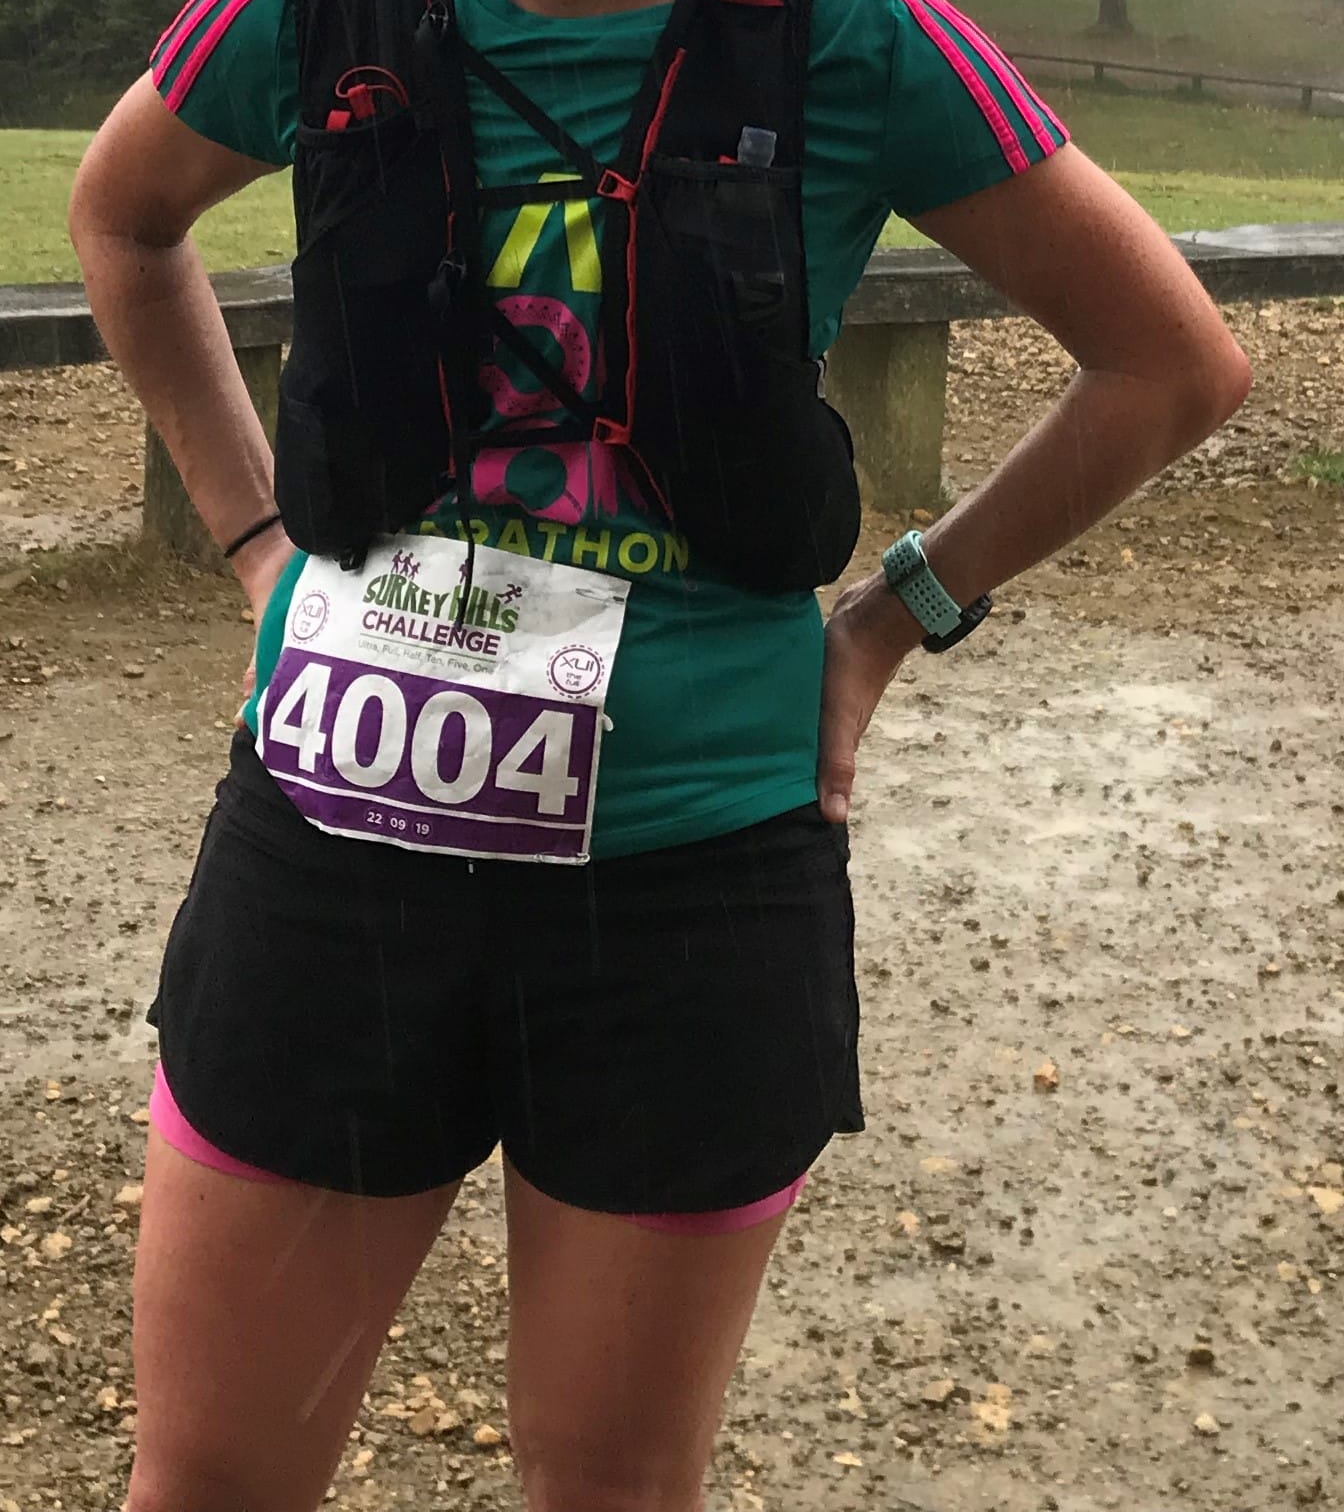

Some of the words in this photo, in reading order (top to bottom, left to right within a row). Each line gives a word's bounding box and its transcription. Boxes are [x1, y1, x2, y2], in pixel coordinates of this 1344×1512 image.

[362, 574, 450, 619] SURREY
[362, 610, 502, 656] CHALLENGE
[269, 662, 579, 816] 4004
[366, 811, 383, 825] 22
[389, 817, 406, 831] 09
[415, 823, 430, 836] 19
